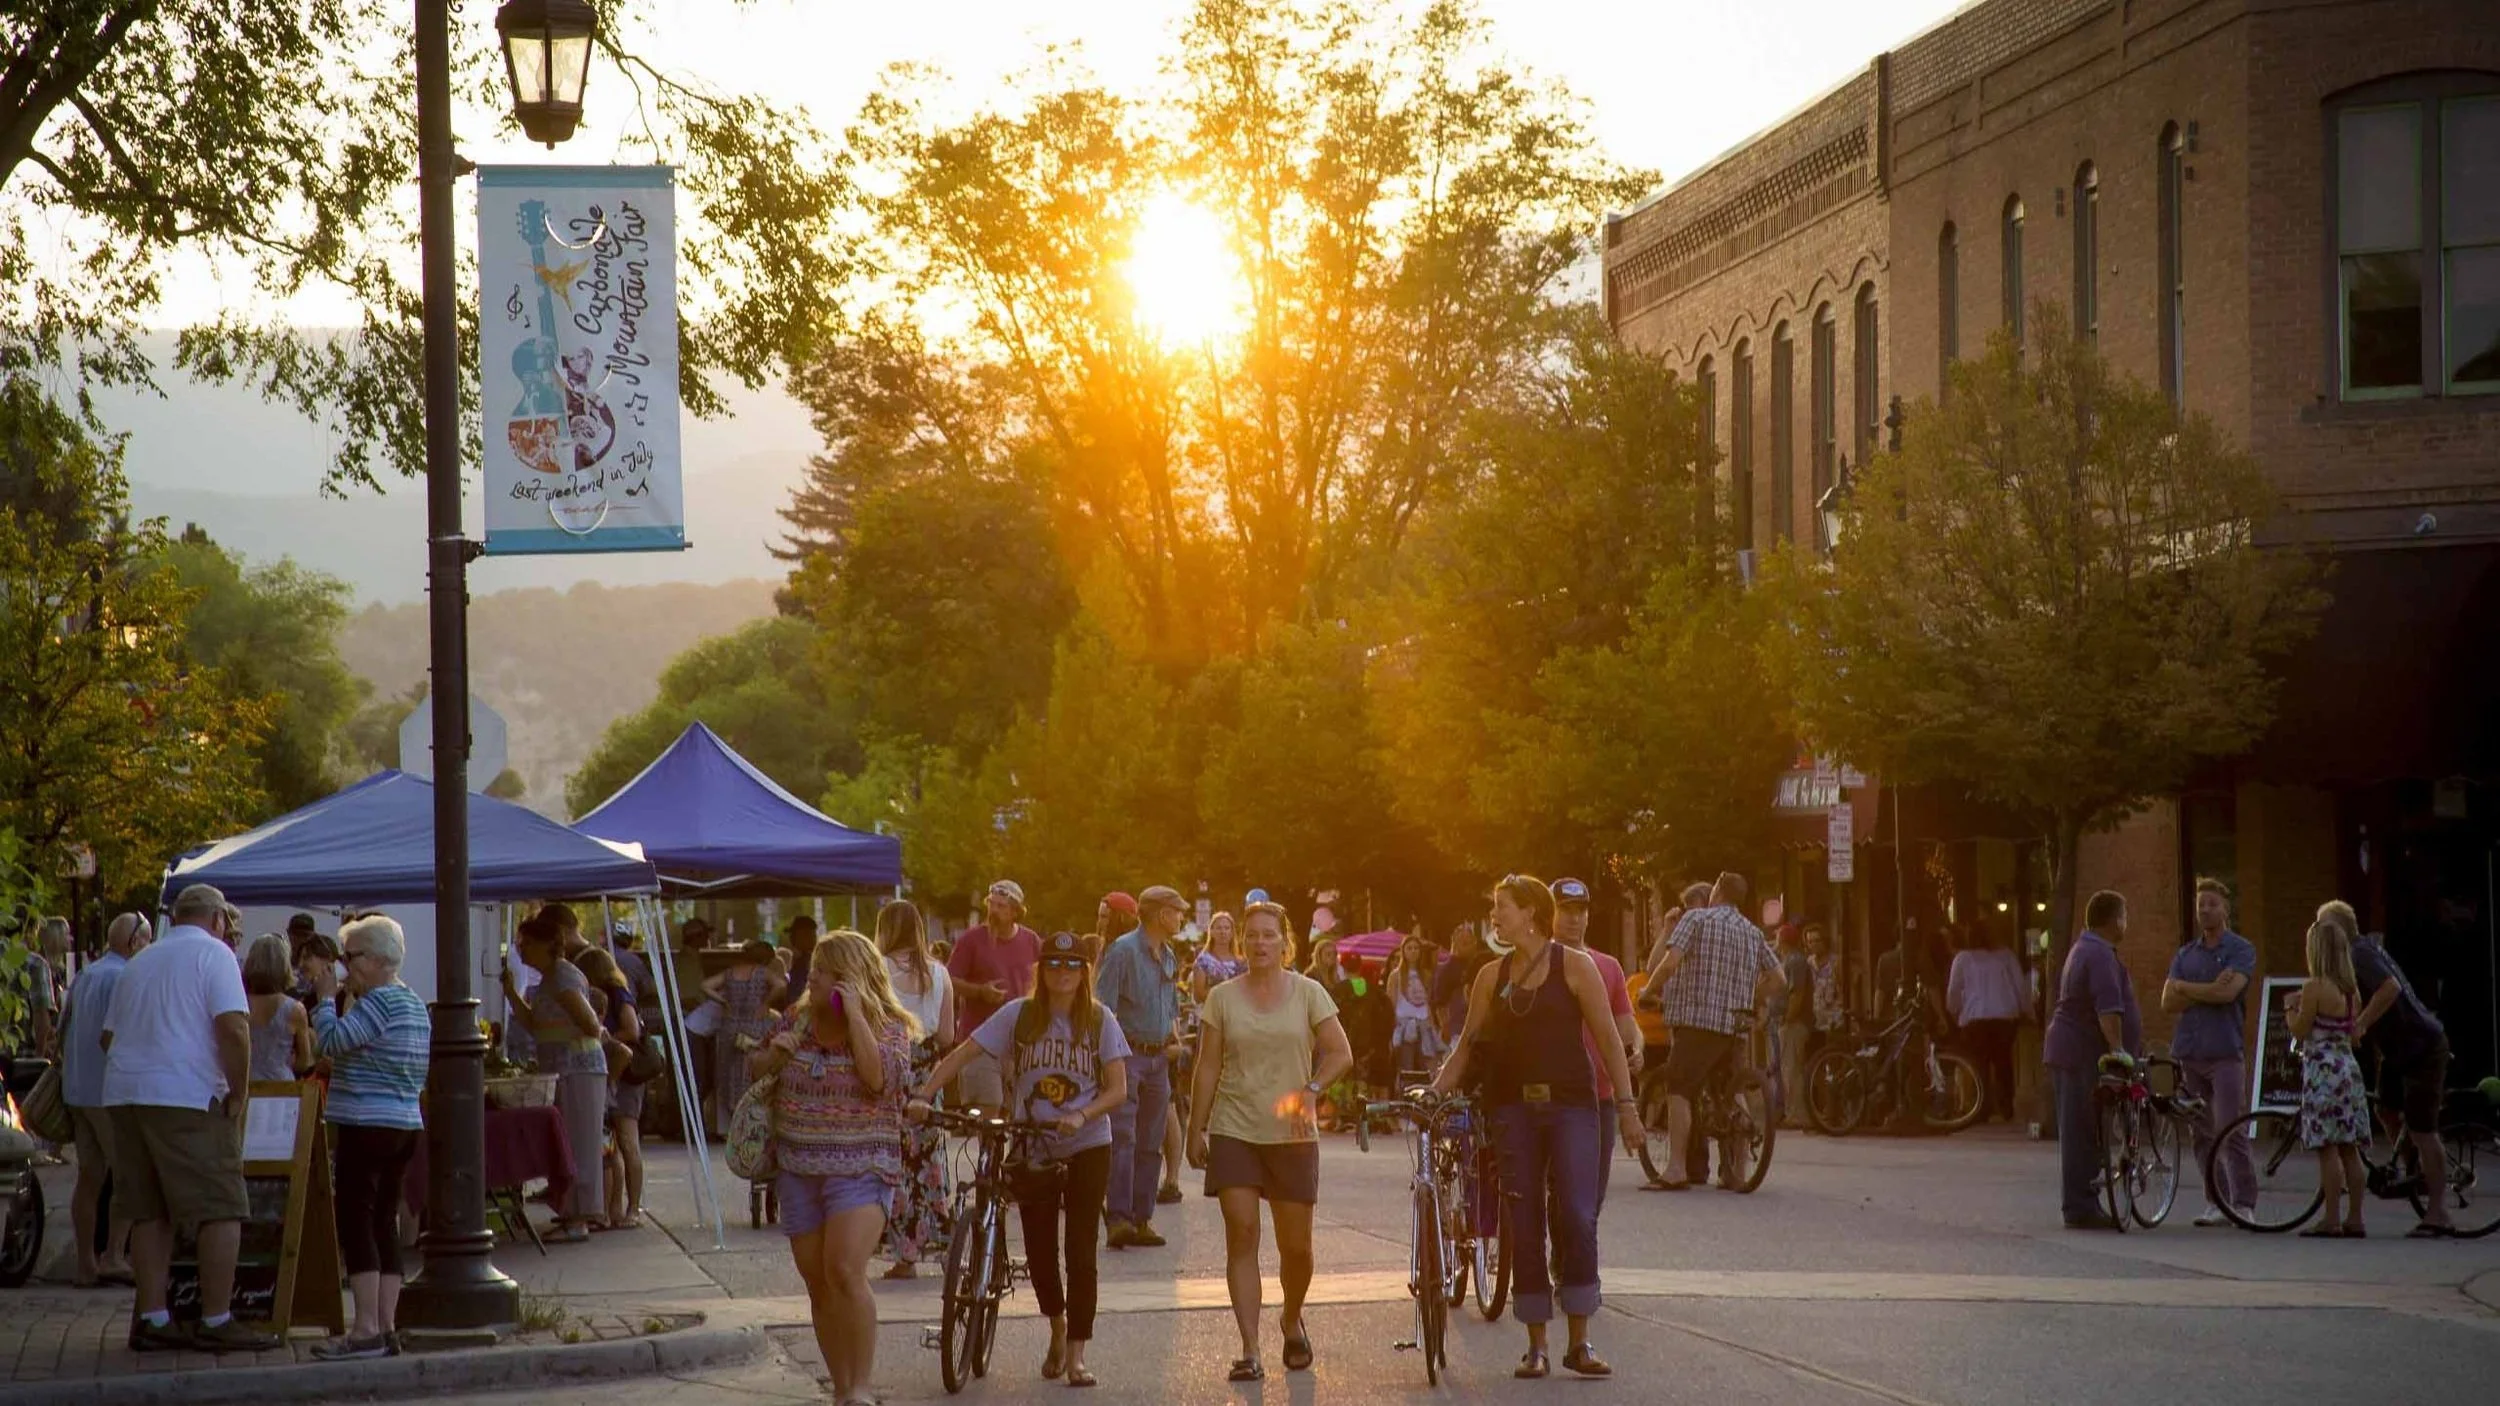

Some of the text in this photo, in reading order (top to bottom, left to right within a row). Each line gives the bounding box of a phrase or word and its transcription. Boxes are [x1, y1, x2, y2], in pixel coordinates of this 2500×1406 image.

[569, 204, 611, 336] Carbondale
[604, 201, 651, 386] Mountain Fair
[510, 440, 654, 502] Last weekend in July
[1015, 1037, 1094, 1079] OLORAD
